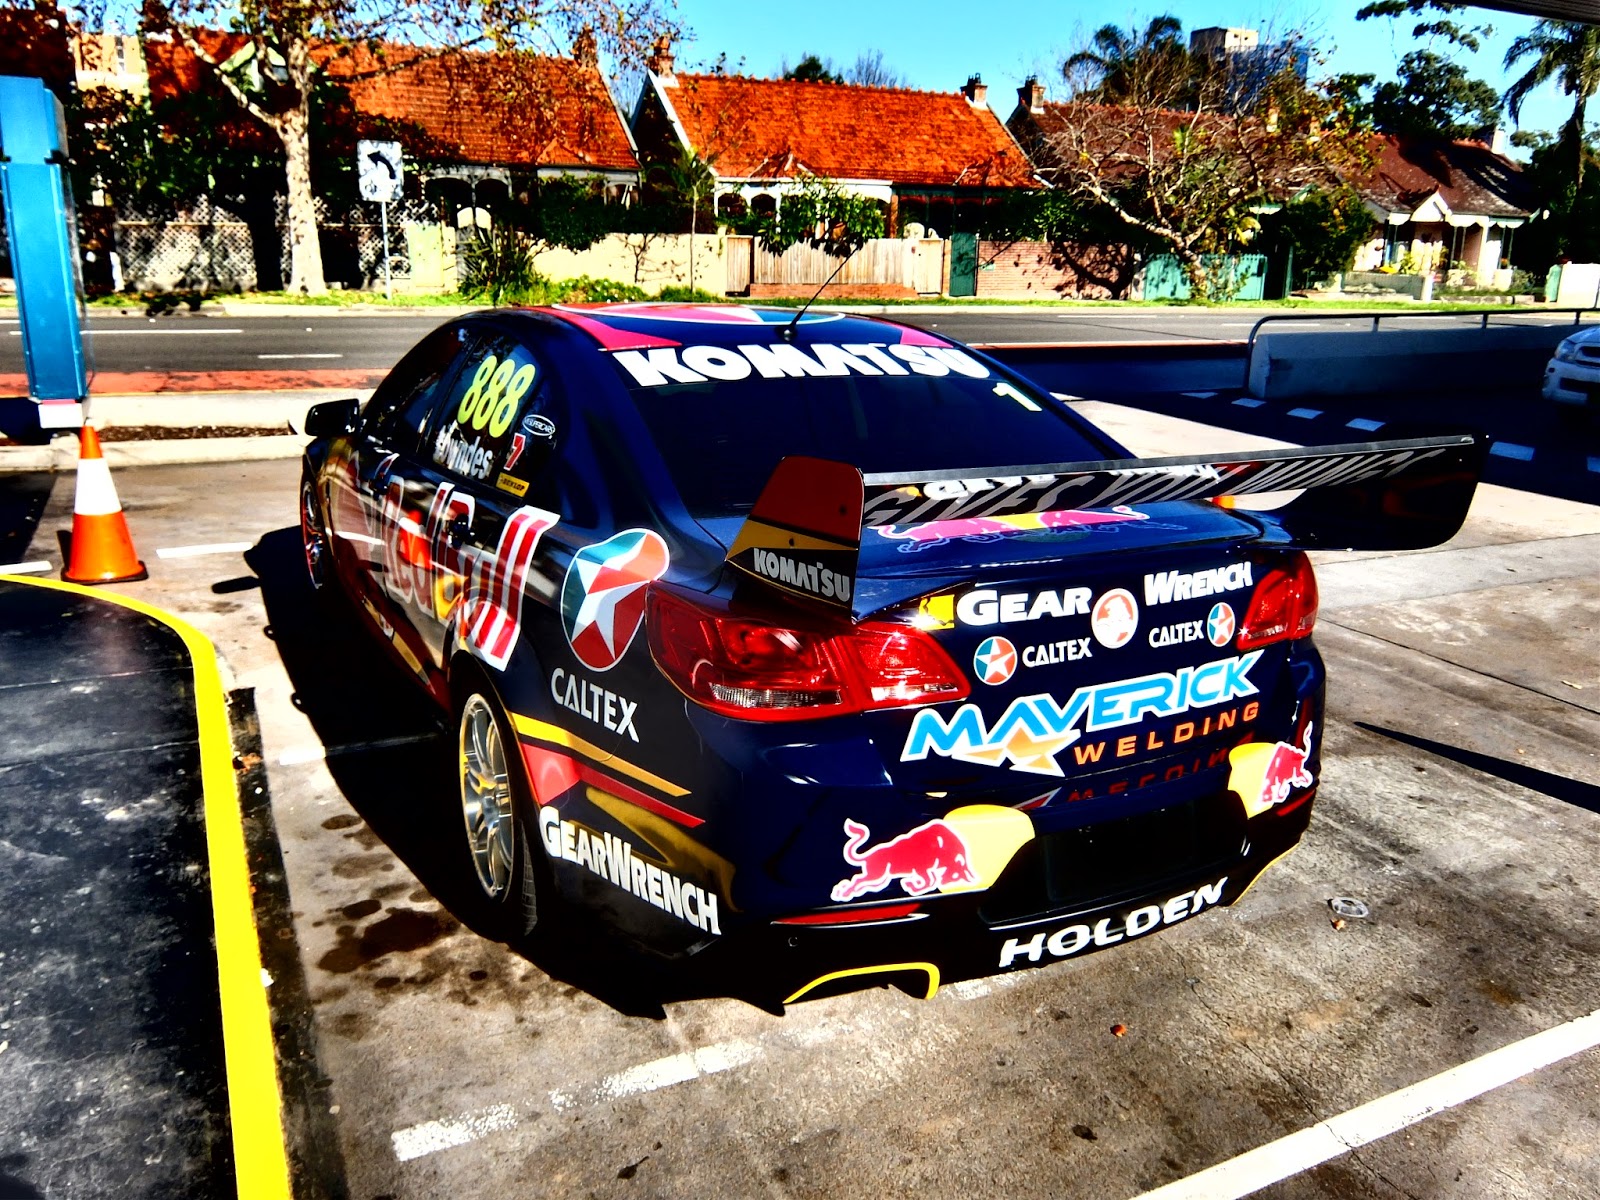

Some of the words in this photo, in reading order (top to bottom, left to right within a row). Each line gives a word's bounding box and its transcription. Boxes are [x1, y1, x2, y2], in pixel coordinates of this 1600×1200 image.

[457, 355, 536, 438] 888
[612, 343, 990, 386] KOMATSU
[993, 382, 1042, 411] 1
[753, 548, 850, 602] KOMATSU
[956, 587, 1092, 626] GEAR
[1144, 561, 1253, 607] WRENCH
[1022, 638, 1093, 668] CALTEX
[1148, 619, 1204, 648] CALTEX
[551, 667, 639, 743] CALTEX
[900, 650, 1265, 768] MAVERICK
[1073, 701, 1260, 766] WELDING
[999, 876, 1229, 968] HOLDEN
